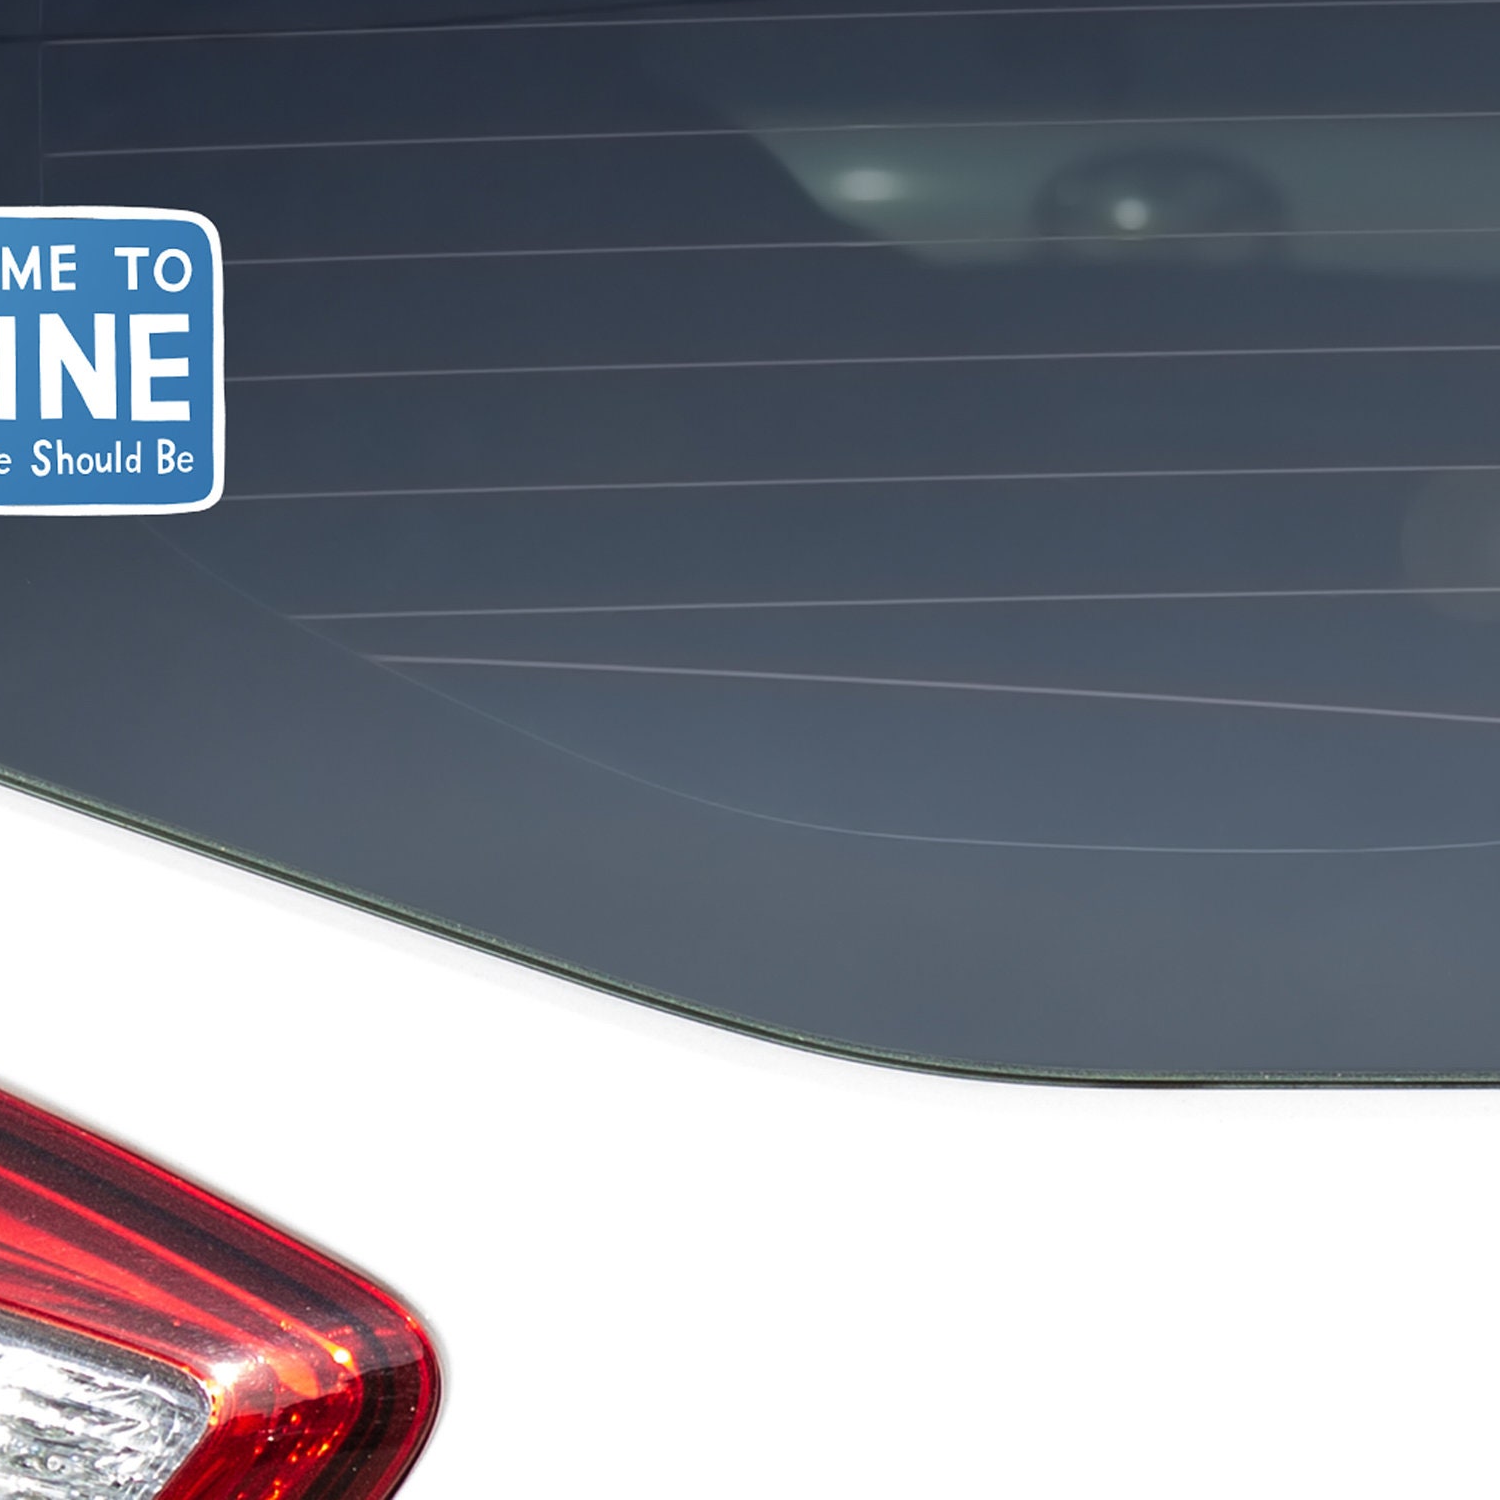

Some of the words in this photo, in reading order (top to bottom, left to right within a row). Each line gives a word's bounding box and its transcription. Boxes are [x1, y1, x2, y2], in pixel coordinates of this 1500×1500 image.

[114, 246, 193, 292] TO
[30, 439, 142, 477] Should
[157, 438, 194, 475] Be
